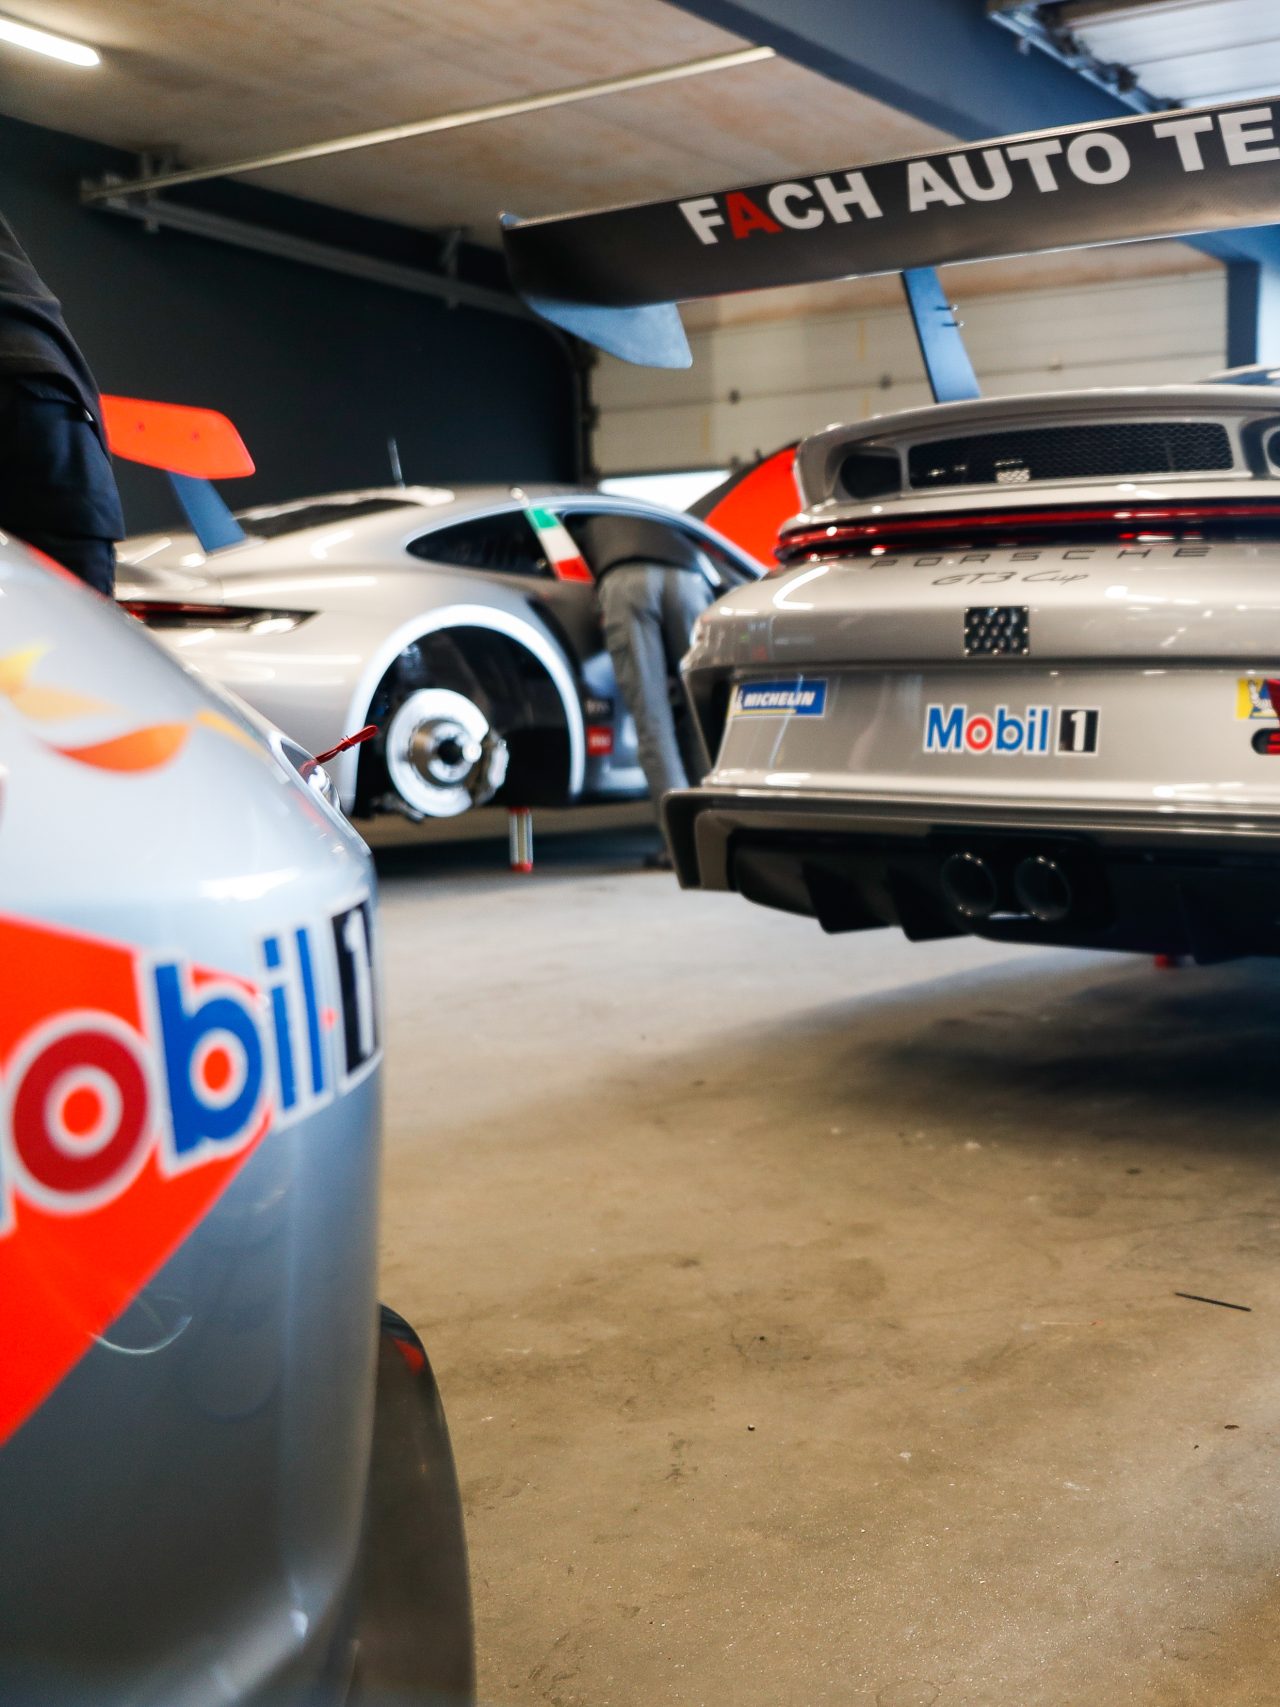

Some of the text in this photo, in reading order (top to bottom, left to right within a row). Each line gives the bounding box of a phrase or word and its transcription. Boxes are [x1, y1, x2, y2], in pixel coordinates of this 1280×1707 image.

[677, 170, 885, 246] FACH
[906, 132, 1131, 213] AUTO
[869, 547, 1213, 569] PORSCHE
[931, 570, 1090, 586] GT3 Cup
[743, 691, 816, 707] MICHELIN
[925, 706, 1051, 753] Mobil
[0, 924, 326, 1202] obil
